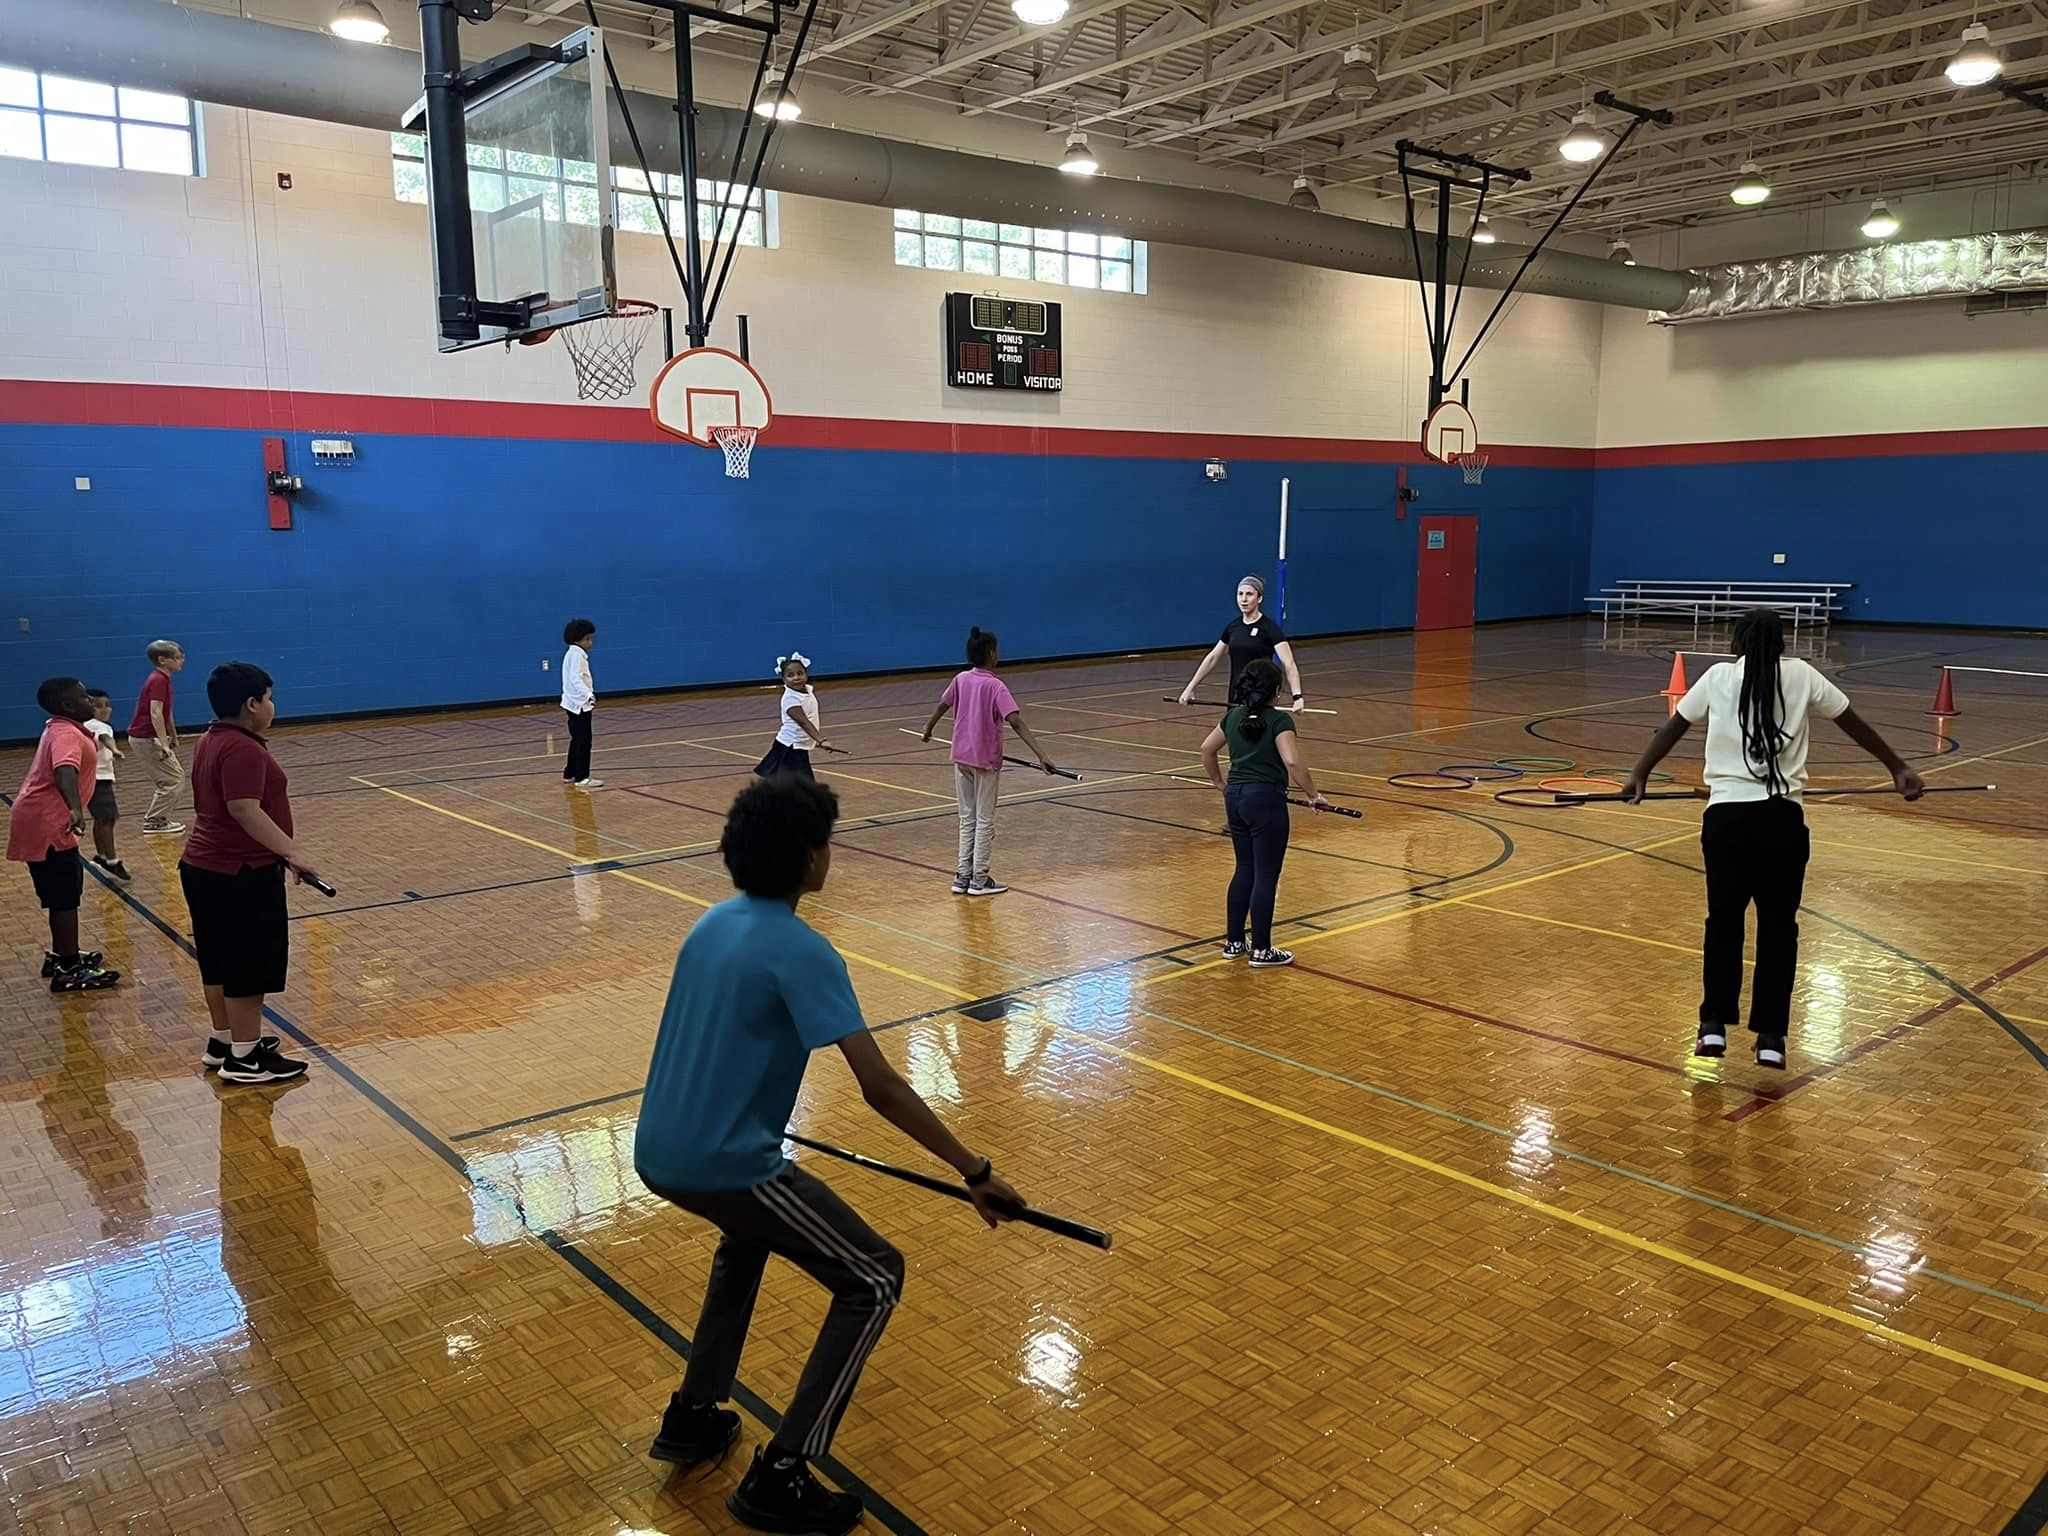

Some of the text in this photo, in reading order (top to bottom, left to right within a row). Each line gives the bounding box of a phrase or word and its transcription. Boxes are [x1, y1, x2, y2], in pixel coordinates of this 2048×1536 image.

[996, 334, 1023, 344] BONUS
[1003, 345, 1018, 353] POSS
[997, 354, 1023, 363] PERIOD
[957, 371, 994, 385] HOME
[1024, 376, 1062, 389] VISITOR
